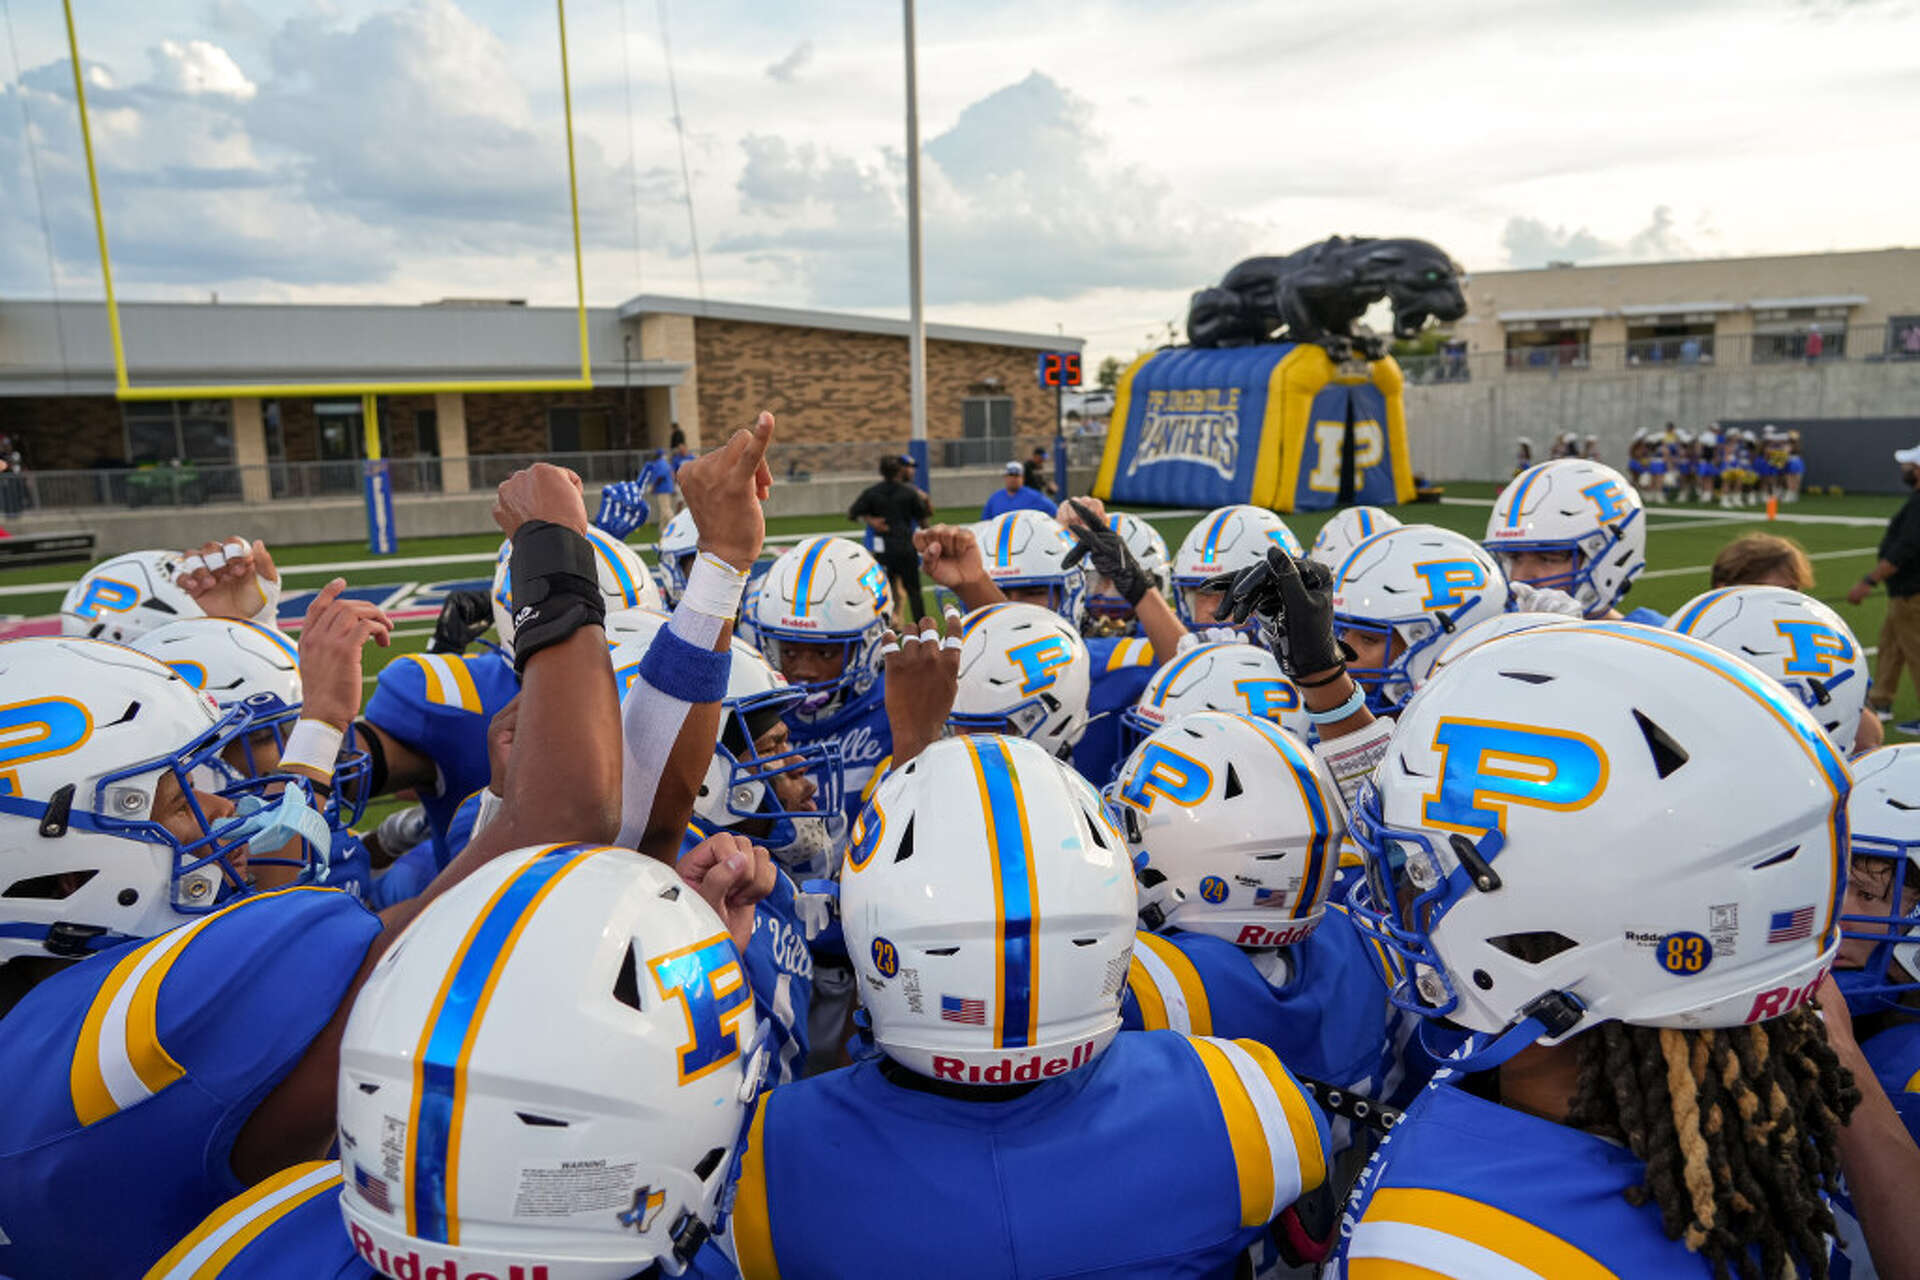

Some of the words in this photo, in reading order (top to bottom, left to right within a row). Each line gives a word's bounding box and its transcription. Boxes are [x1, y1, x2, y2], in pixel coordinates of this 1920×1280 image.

[1045, 355, 1082, 385] 25
[1309, 419, 1385, 493] P
[74, 576, 141, 622] P
[1413, 558, 1488, 612] P
[1005, 634, 1075, 698] P
[1772, 619, 1856, 677] P
[1233, 678, 1300, 726] P
[1119, 740, 1214, 815] P
[1421, 716, 1610, 840] P
[1204, 878, 1224, 902] 24
[874, 939, 895, 975] 23
[1666, 937, 1703, 971] 83
[645, 930, 754, 1088] P
[932, 1041, 1094, 1083] Riddell
